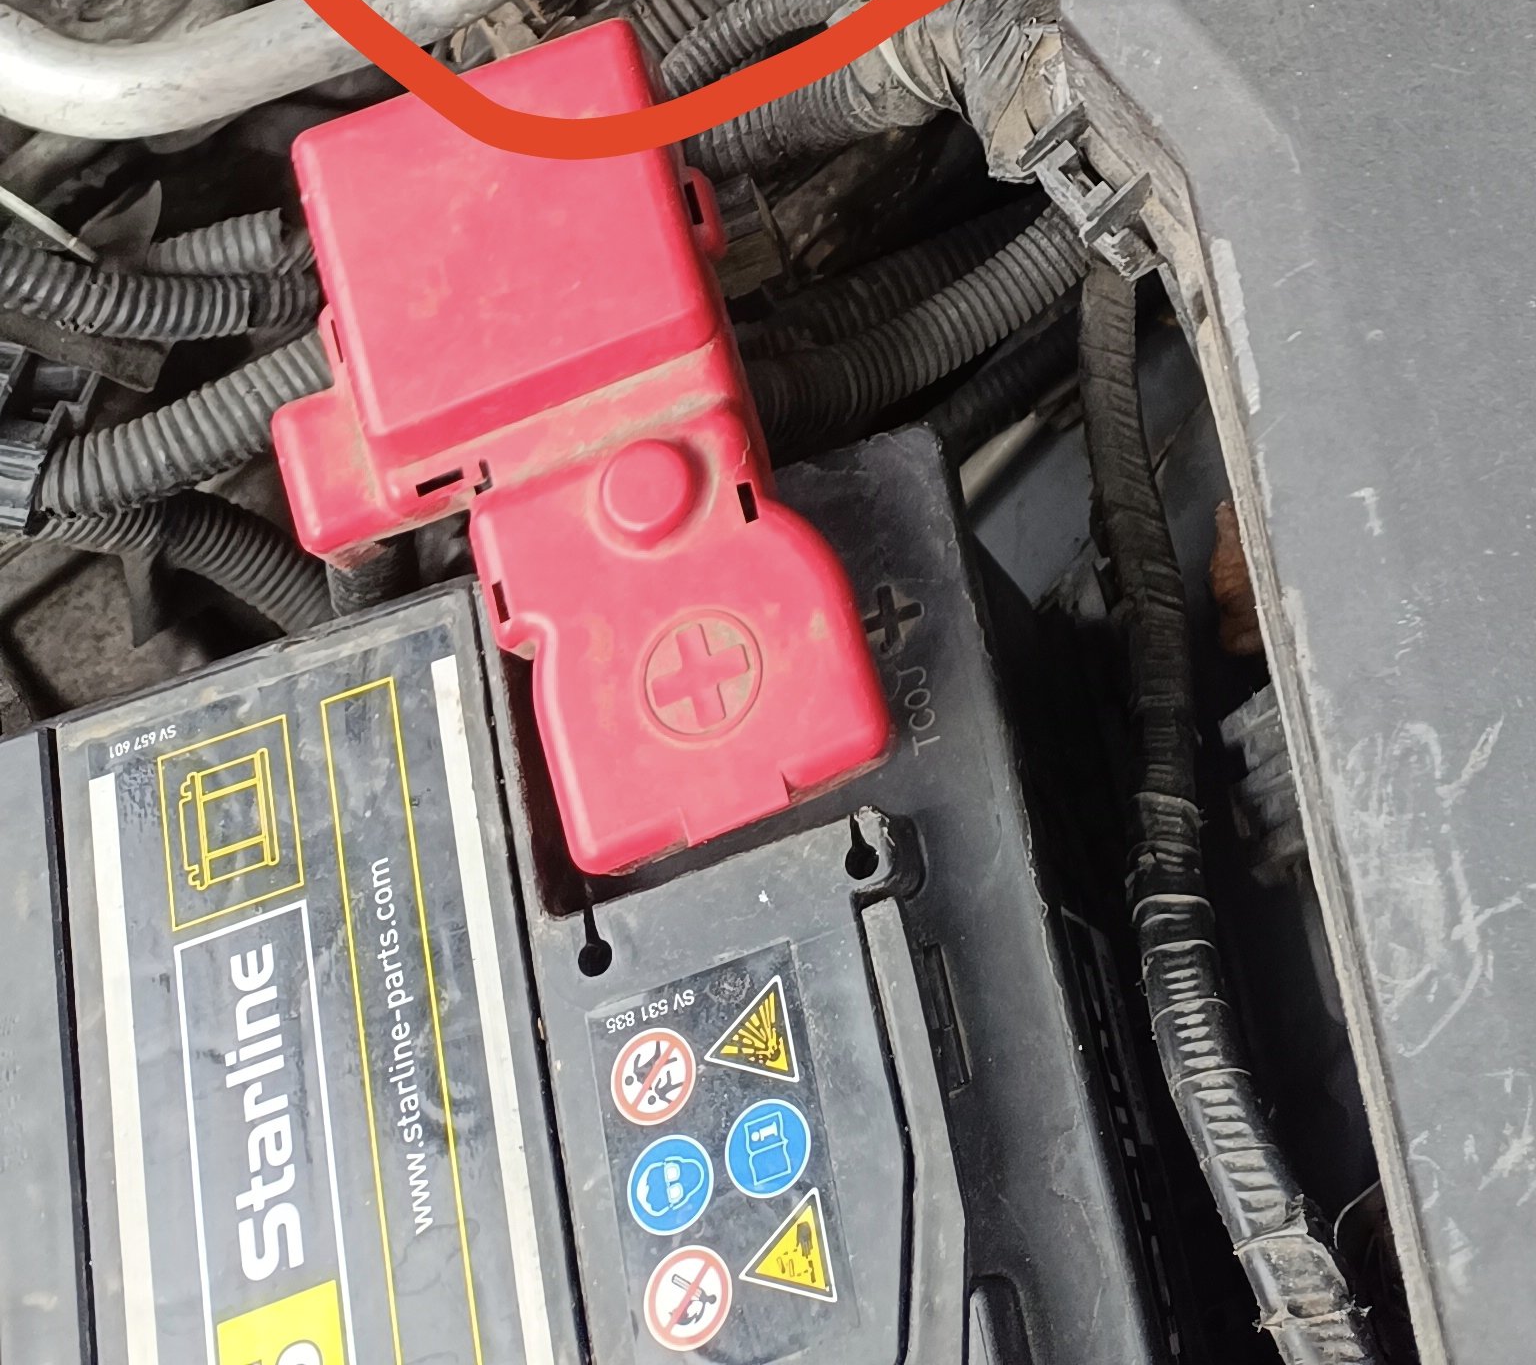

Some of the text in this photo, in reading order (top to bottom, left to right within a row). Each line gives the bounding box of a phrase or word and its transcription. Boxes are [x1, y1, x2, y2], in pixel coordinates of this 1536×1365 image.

[106, 723, 178, 758] SV 657 601
[374, 856, 434, 1236] www.starline-parts.com
[604, 987, 696, 1033] SV 531 835
[221, 941, 305, 1281] Starline
